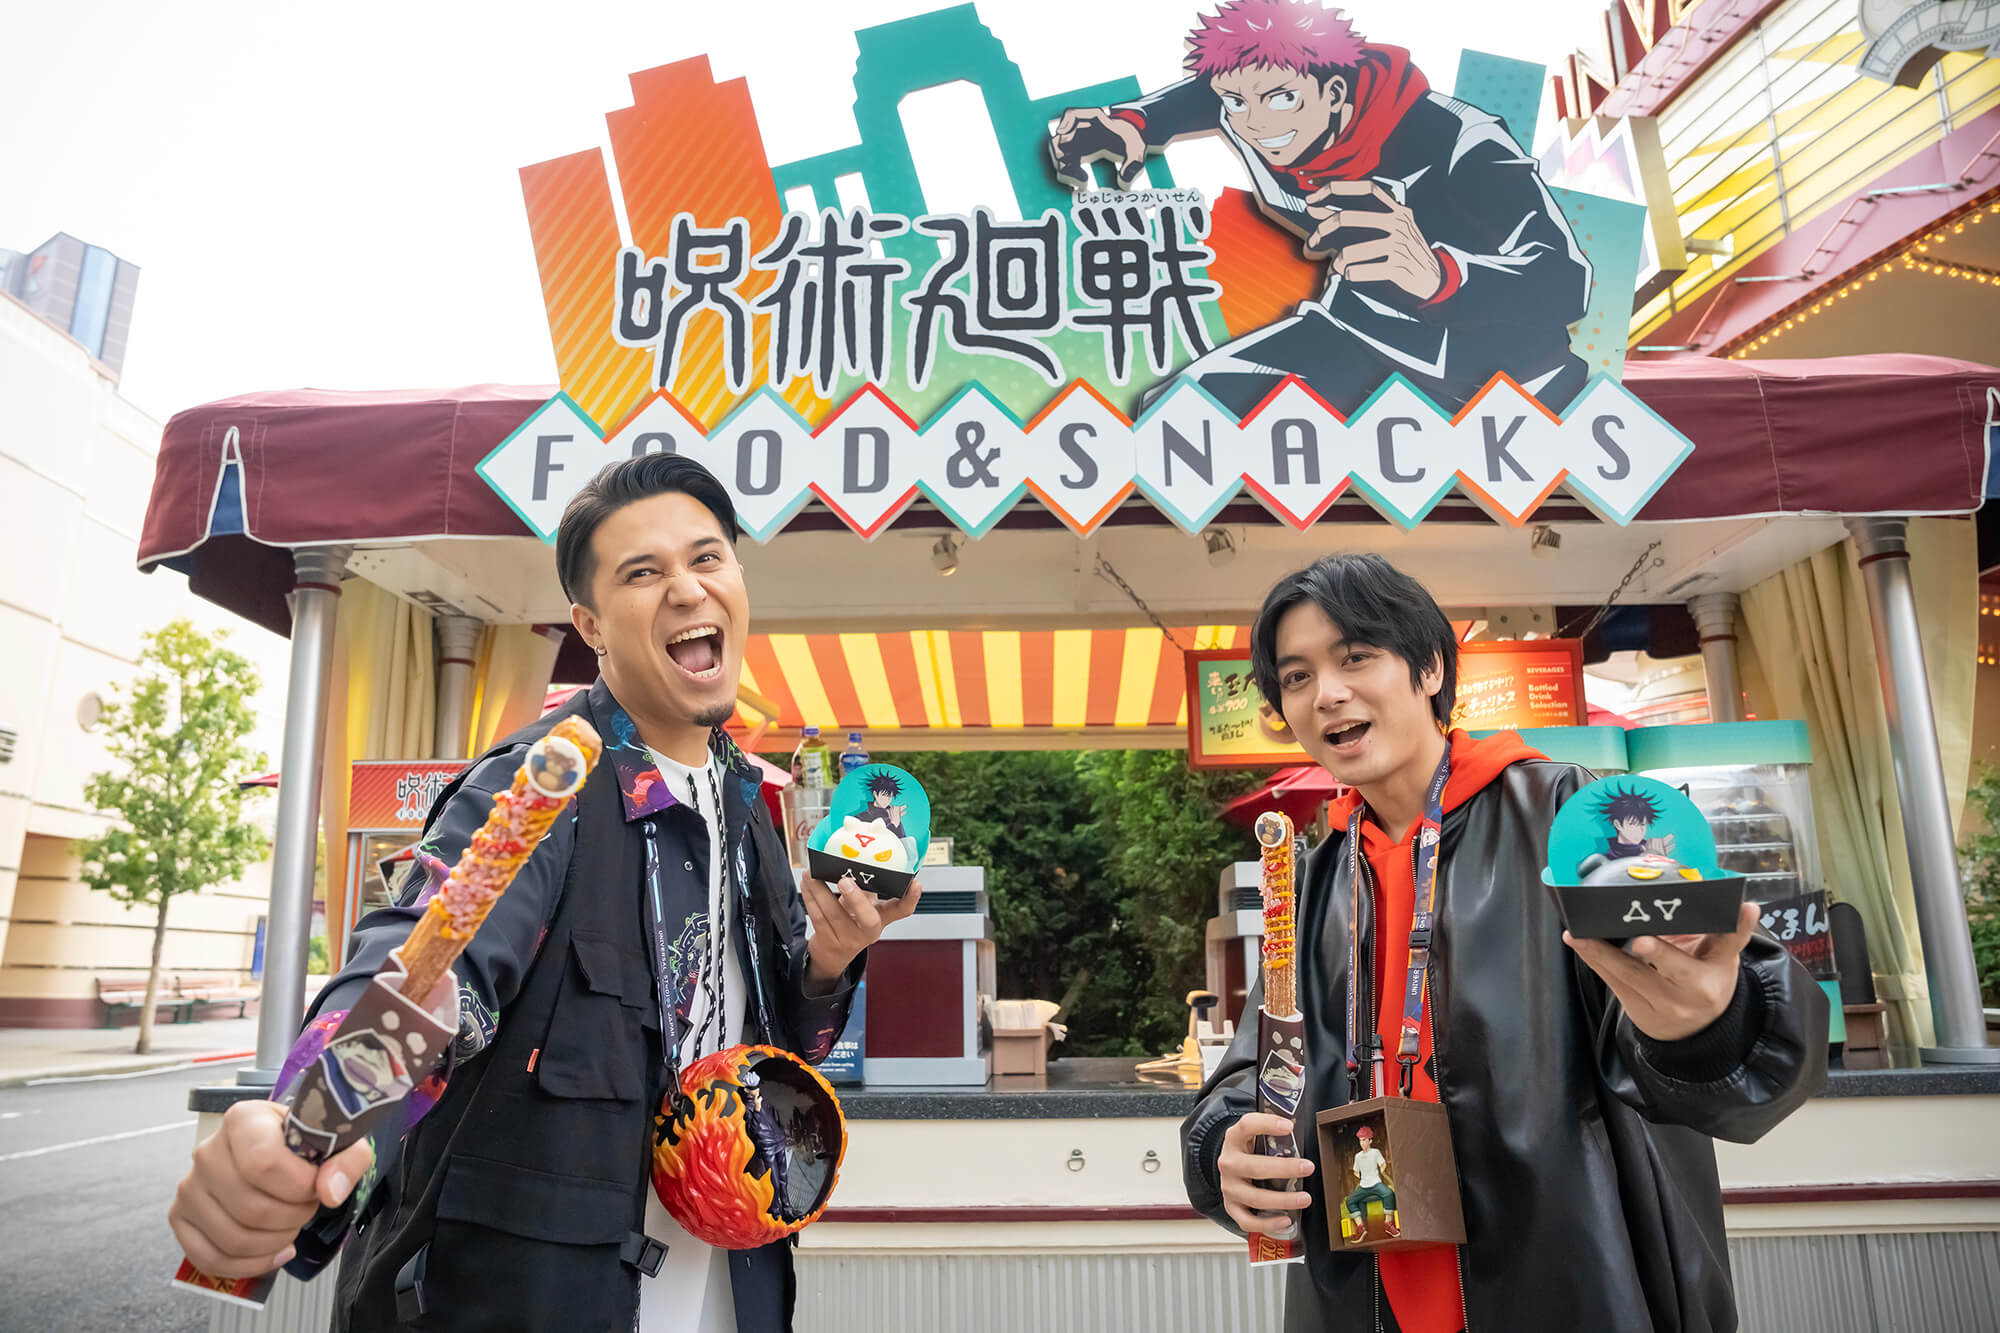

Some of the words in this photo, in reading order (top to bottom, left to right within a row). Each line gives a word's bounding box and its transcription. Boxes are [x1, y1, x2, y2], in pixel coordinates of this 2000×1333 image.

[1076, 191, 1201, 205] じゅじゅつかいせん
[620, 205, 1217, 392] 呪術廻戦
[1528, 683, 1559, 692] Bottled
[1529, 692, 1552, 700] Drink
[1530, 701, 1568, 709] Selection
[658, 930, 667, 971] UNIVERSAL
[667, 1011, 675, 1037] JAPAN
